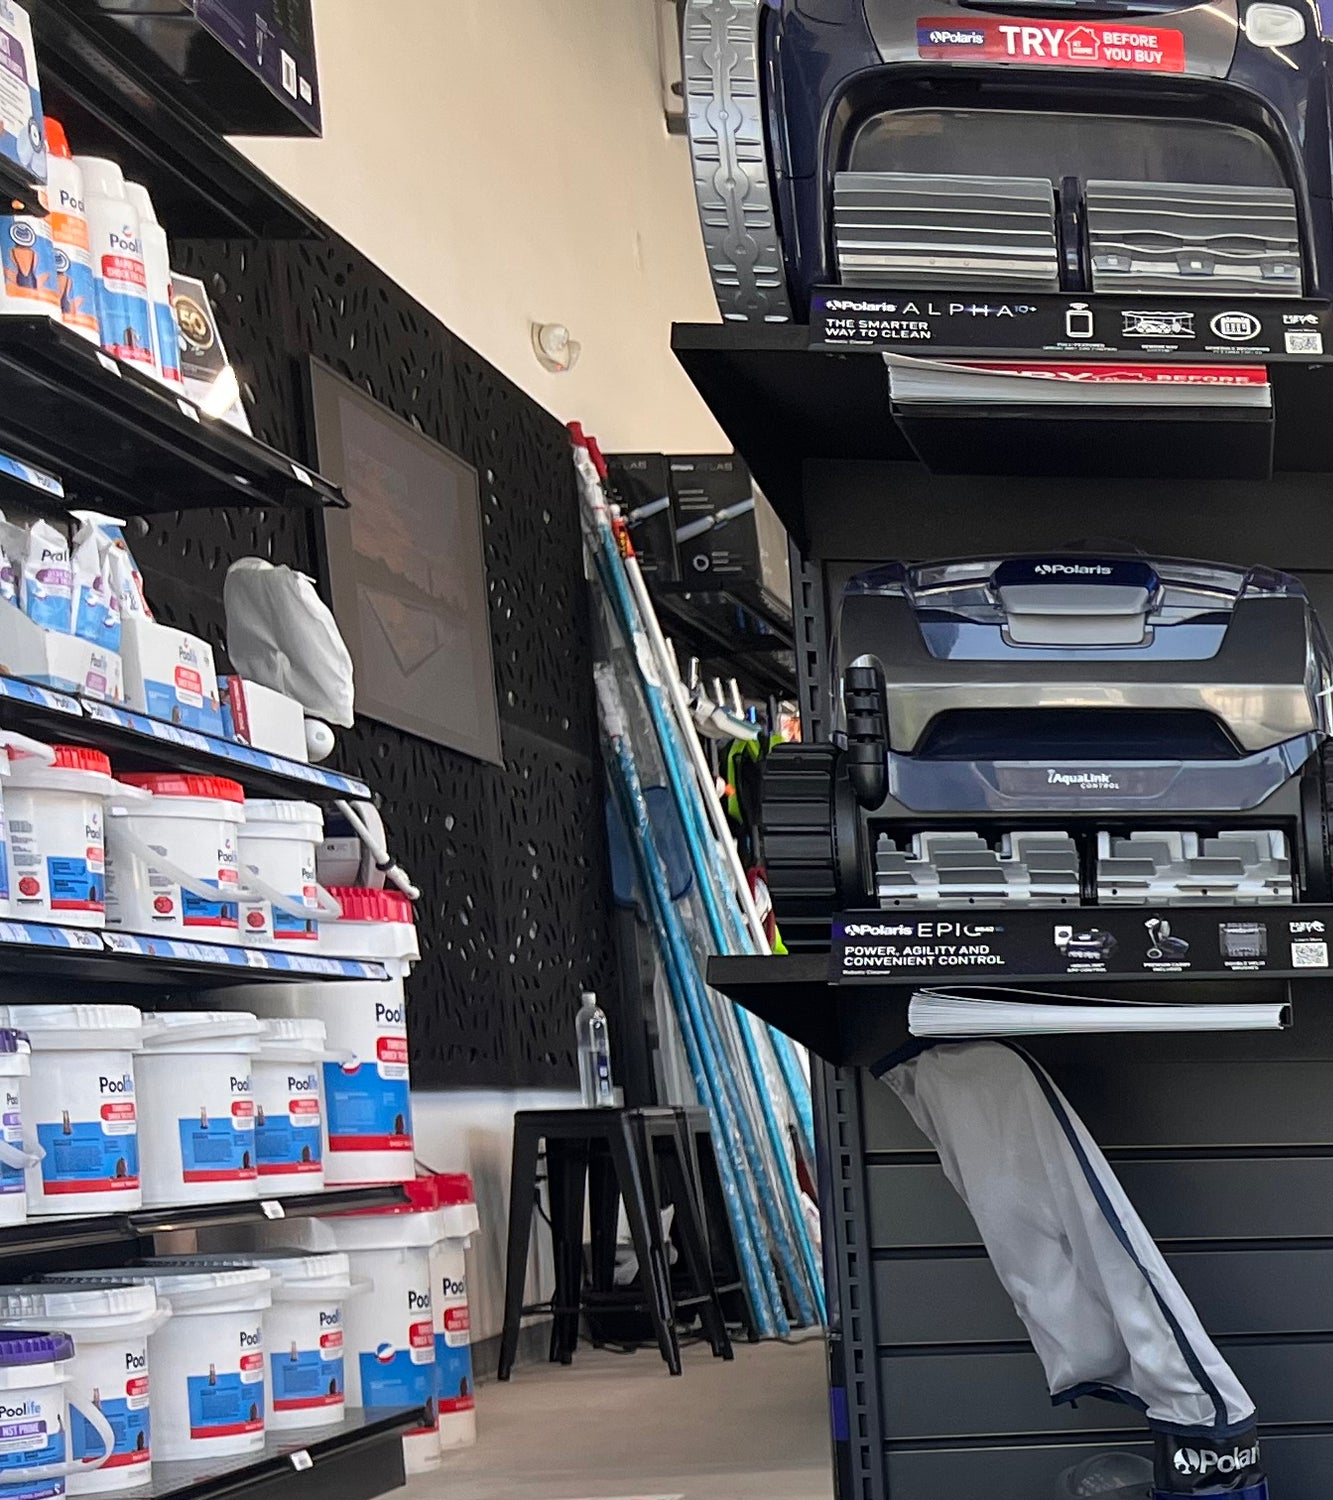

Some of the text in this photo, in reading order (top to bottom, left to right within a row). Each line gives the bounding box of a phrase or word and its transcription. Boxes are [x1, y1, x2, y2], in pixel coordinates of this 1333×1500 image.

[941, 30, 984, 45] Polaris
[998, 25, 1063, 58] TRY
[1103, 31, 1158, 49] BEFORE
[1103, 47, 1164, 64] YOU BUY
[843, 301, 896, 313] Polaris
[902, 302, 1015, 317] ALPHA
[826, 318, 929, 331] THE SMARTER
[825, 327, 931, 340] WAY TO CLEAN
[1050, 564, 1113, 576] Polaris
[859, 924, 913, 936] Polaris
[917, 922, 983, 938] EPIC
[844, 945, 990, 957] POWER, AGILITY AND
[843, 955, 1006, 967] CONVENIENT CONTROL
[2, 1423, 40, 1437] NST PRIME
